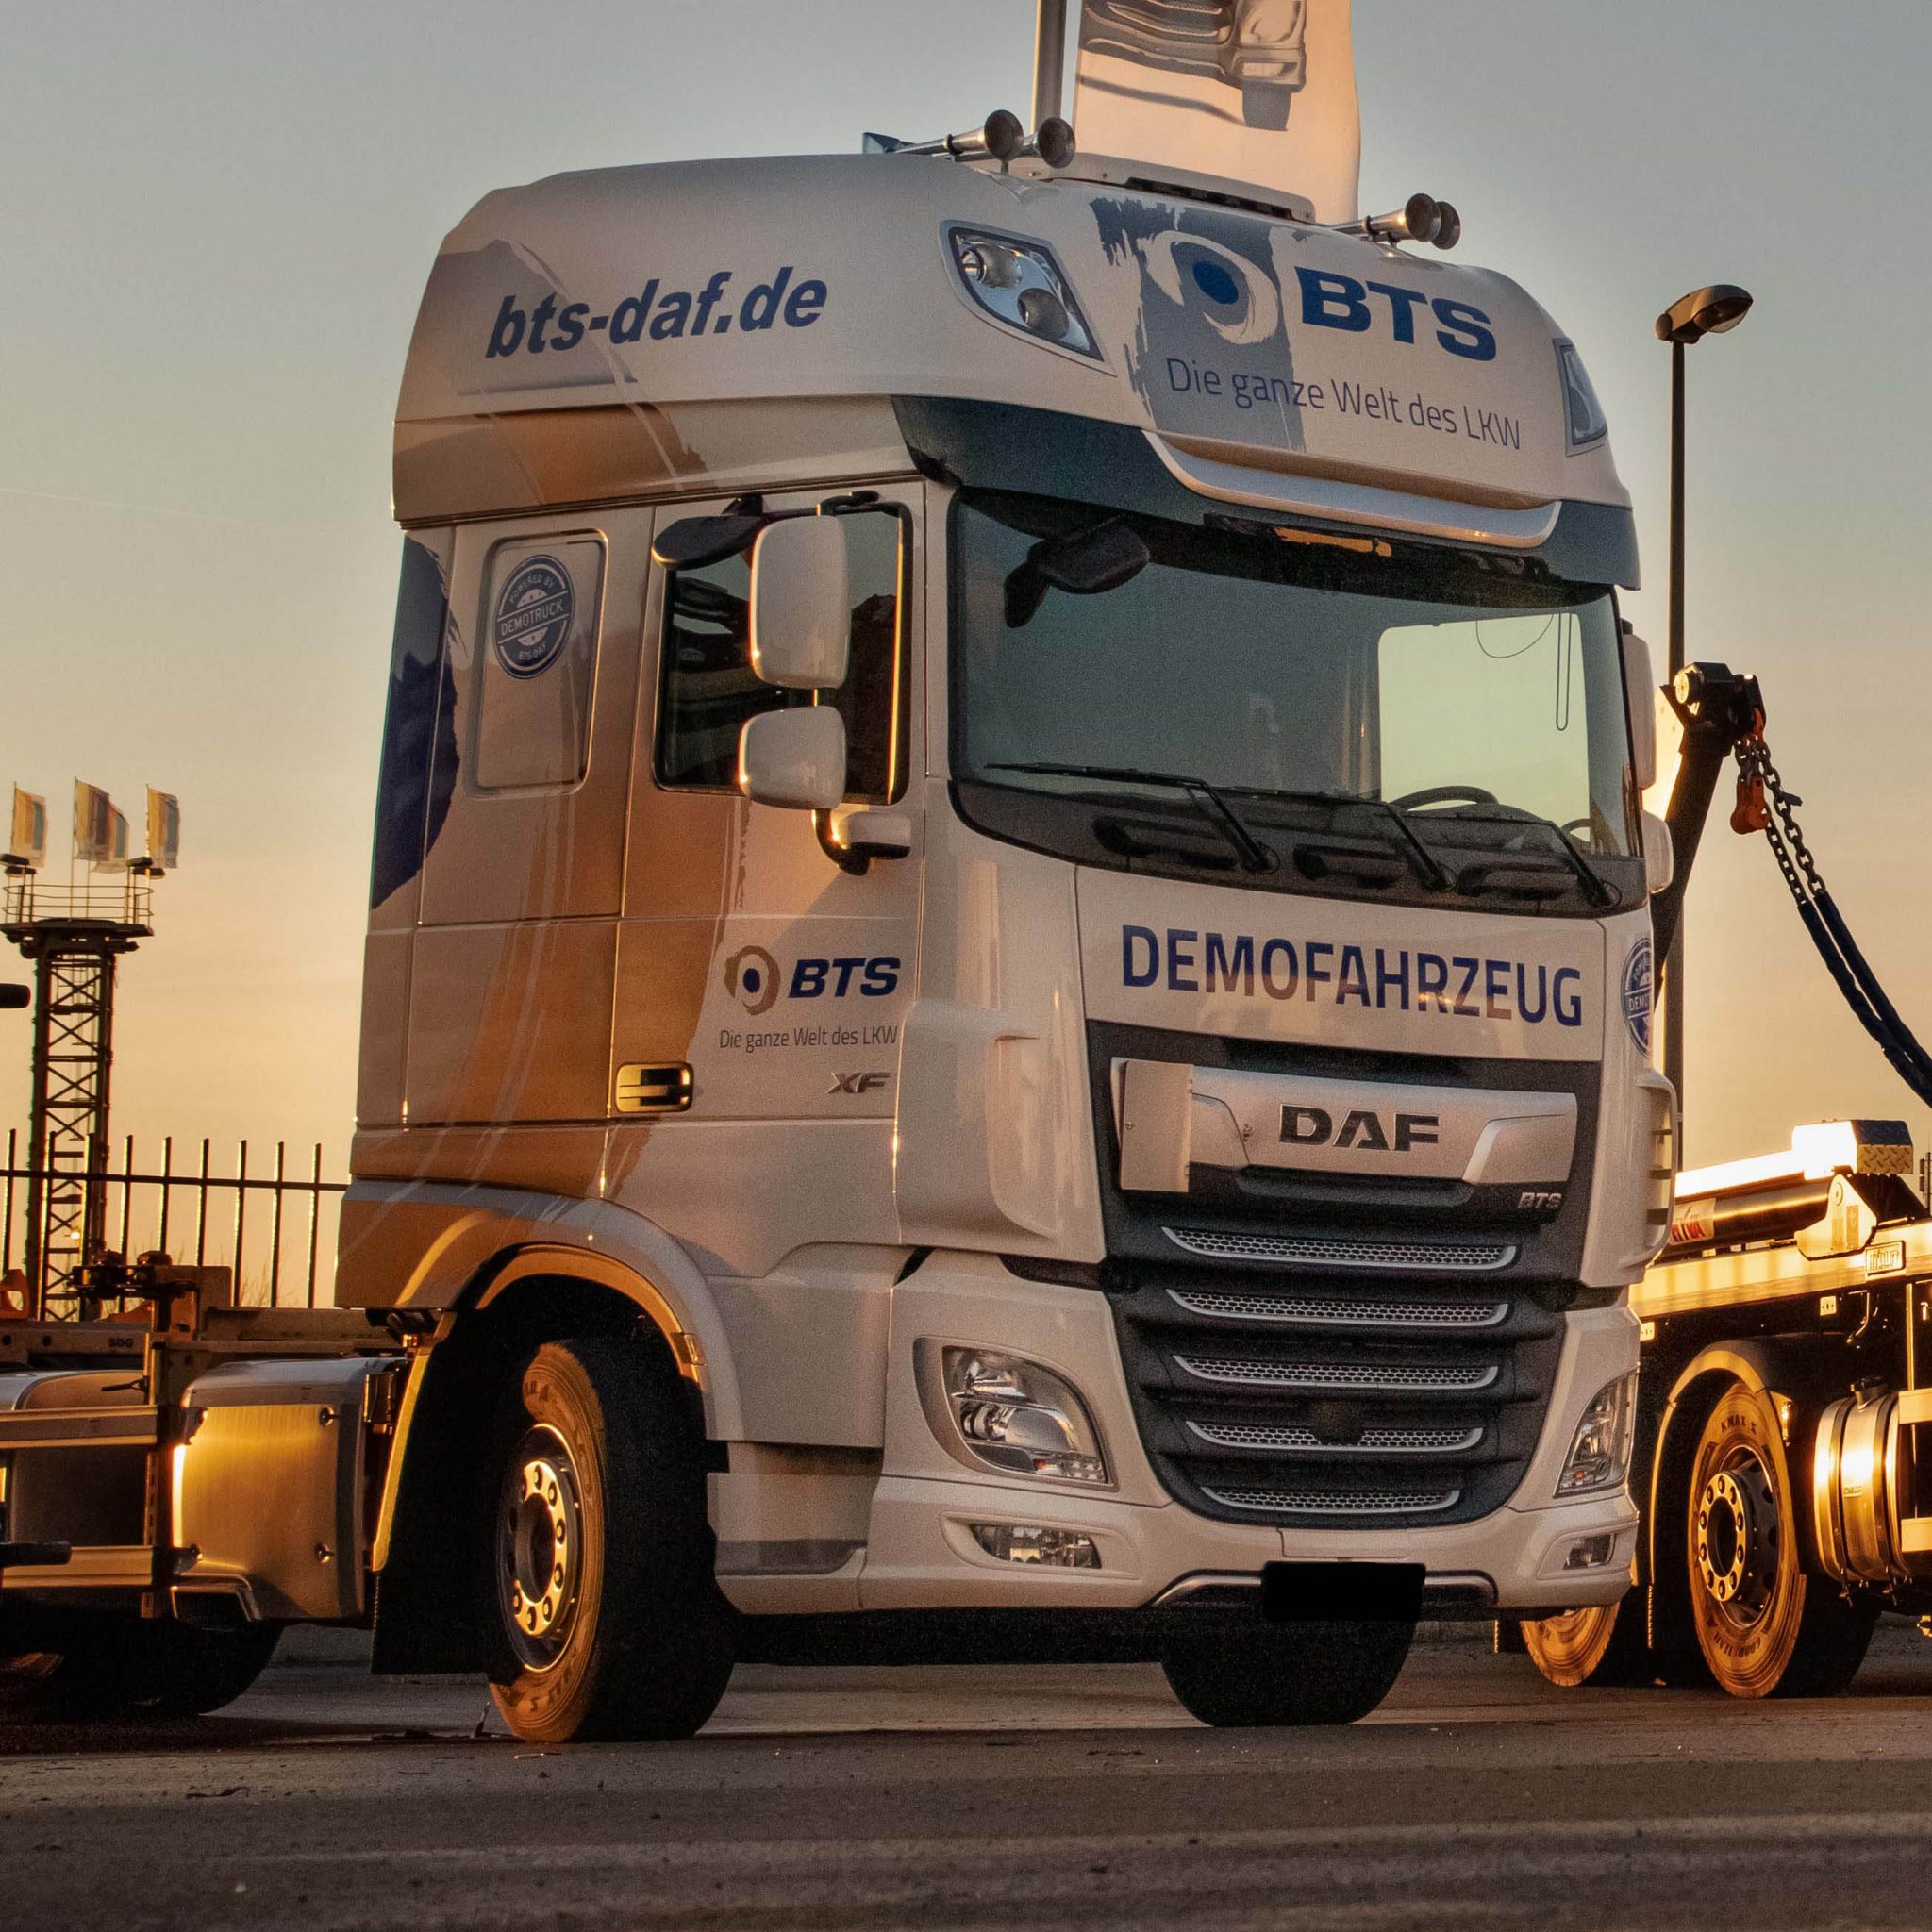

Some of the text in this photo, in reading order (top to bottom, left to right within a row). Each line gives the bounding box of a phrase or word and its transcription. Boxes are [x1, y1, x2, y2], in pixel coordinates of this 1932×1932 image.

[485, 266, 827, 358] bts-daf.de
[1294, 265, 1497, 361] BTS
[1166, 357, 1521, 450] Die ganze Welt des LKW
[500, 598, 564, 636] DEMOTRUCK
[788, 957, 901, 998] BTS
[1122, 924, 1583, 1027] DEMOFAHRZEUG
[719, 1025, 898, 1053] Die ganze Welt des LKW
[825, 1072, 891, 1093] XF
[1279, 1103, 1440, 1151] DAF
[1518, 1192, 1562, 1208] BTS
